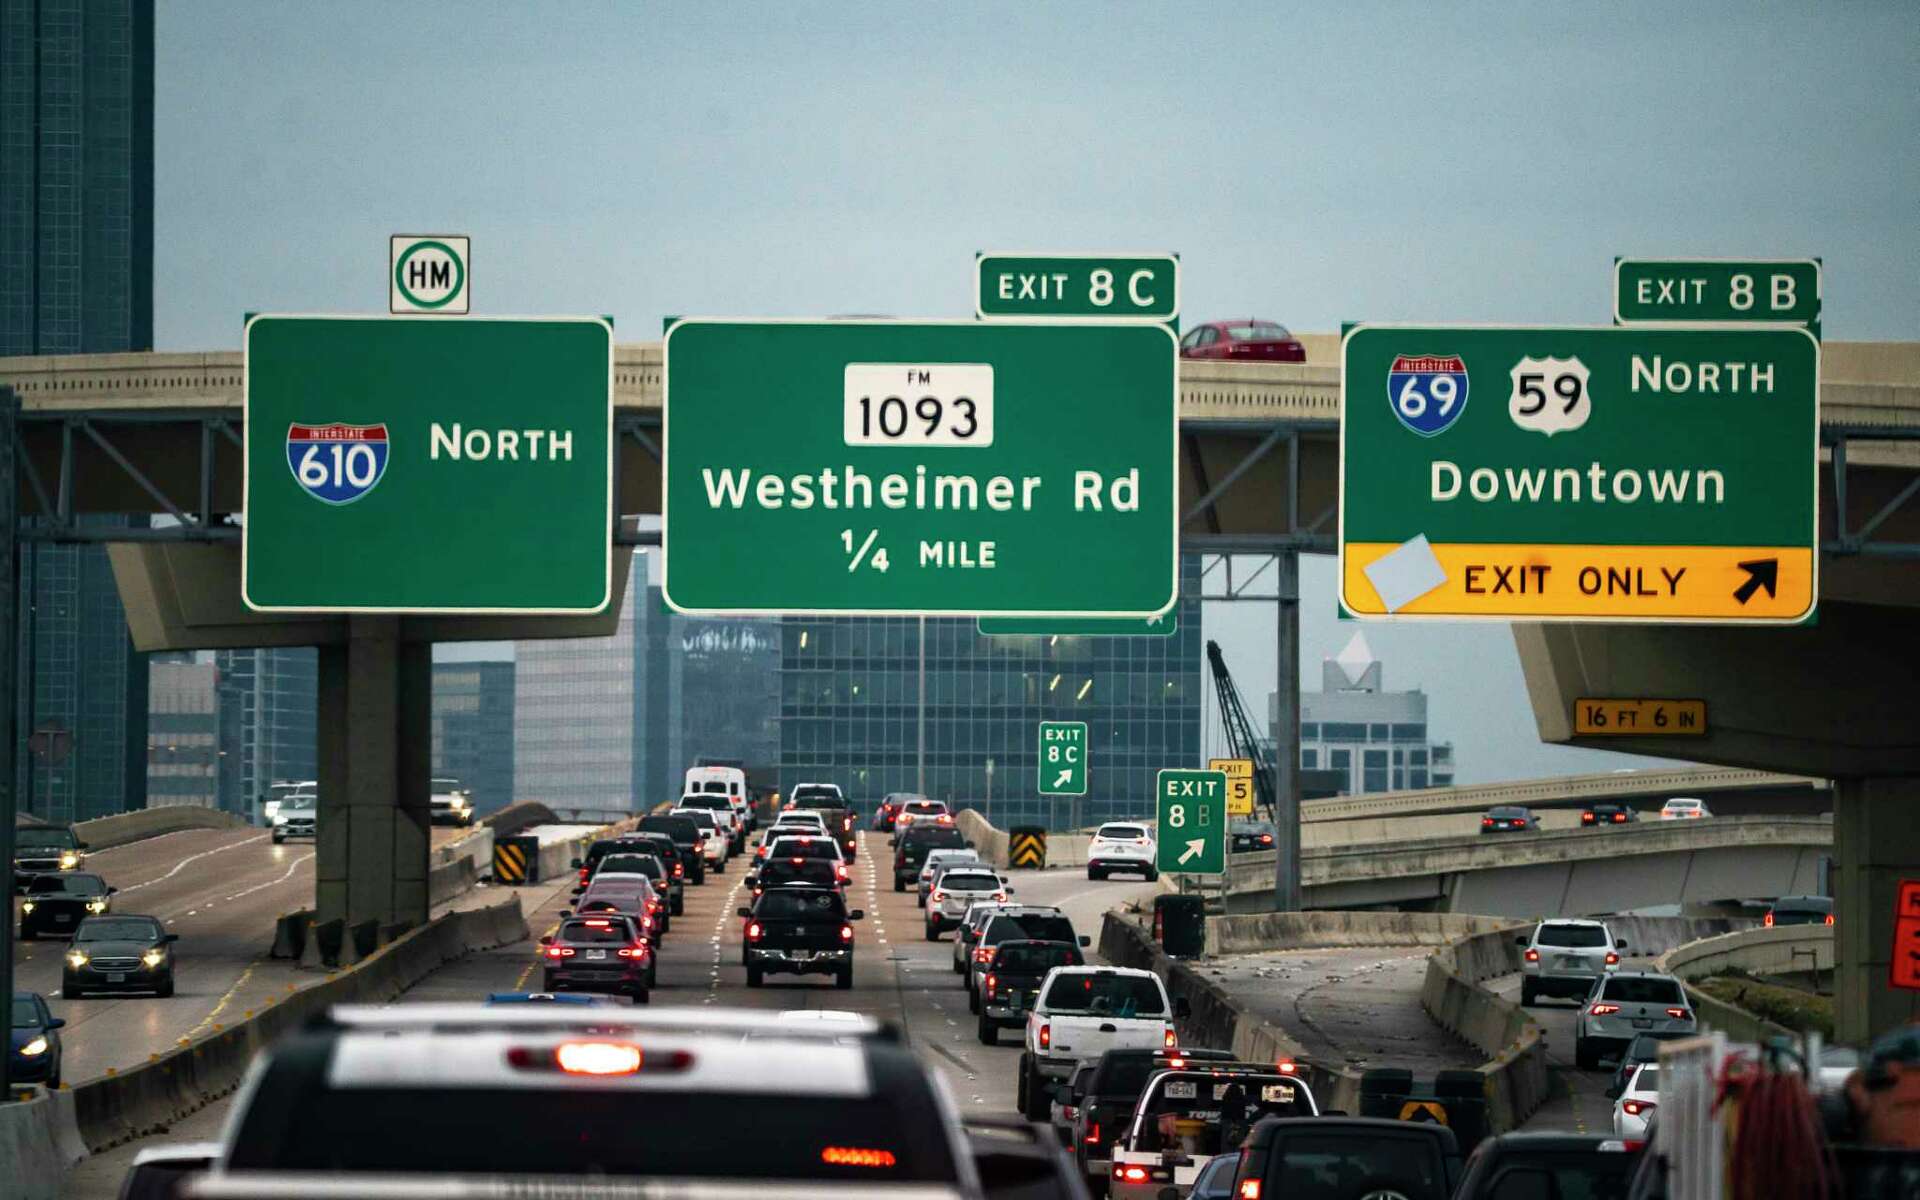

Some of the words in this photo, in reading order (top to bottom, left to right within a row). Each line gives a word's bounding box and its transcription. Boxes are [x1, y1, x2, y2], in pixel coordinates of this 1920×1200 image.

[410, 261, 450, 289] HM
[999, 273, 1069, 300] EXIT
[1637, 278, 1707, 305] EXIT
[907, 370, 931, 384] FM
[1400, 361, 1454, 371] INTERSTATE
[1631, 354, 1774, 394] NORTH
[1399, 375, 1457, 418] 69
[1518, 373, 1582, 416] 59
[859, 396, 978, 438] 1093
[309, 428, 366, 440] INTERSTATE
[430, 422, 573, 461] NORTH
[299, 444, 377, 488] 610
[702, 465, 1042, 510] Westheimer
[1075, 468, 1140, 512] Rd
[1431, 461, 1725, 504] Downtown
[919, 540, 996, 569] MILE
[1464, 565, 1552, 594] EXIT
[1578, 566, 1687, 596] ONLY
[1586, 706, 1607, 727] 16
[1618, 711, 1638, 727] FT
[1654, 706, 1668, 727] 6
[1679, 711, 1695, 727] IN
[1045, 729, 1081, 741] EXIT
[1218, 764, 1243, 774] EXIT
[1167, 780, 1218, 797] EXIT
